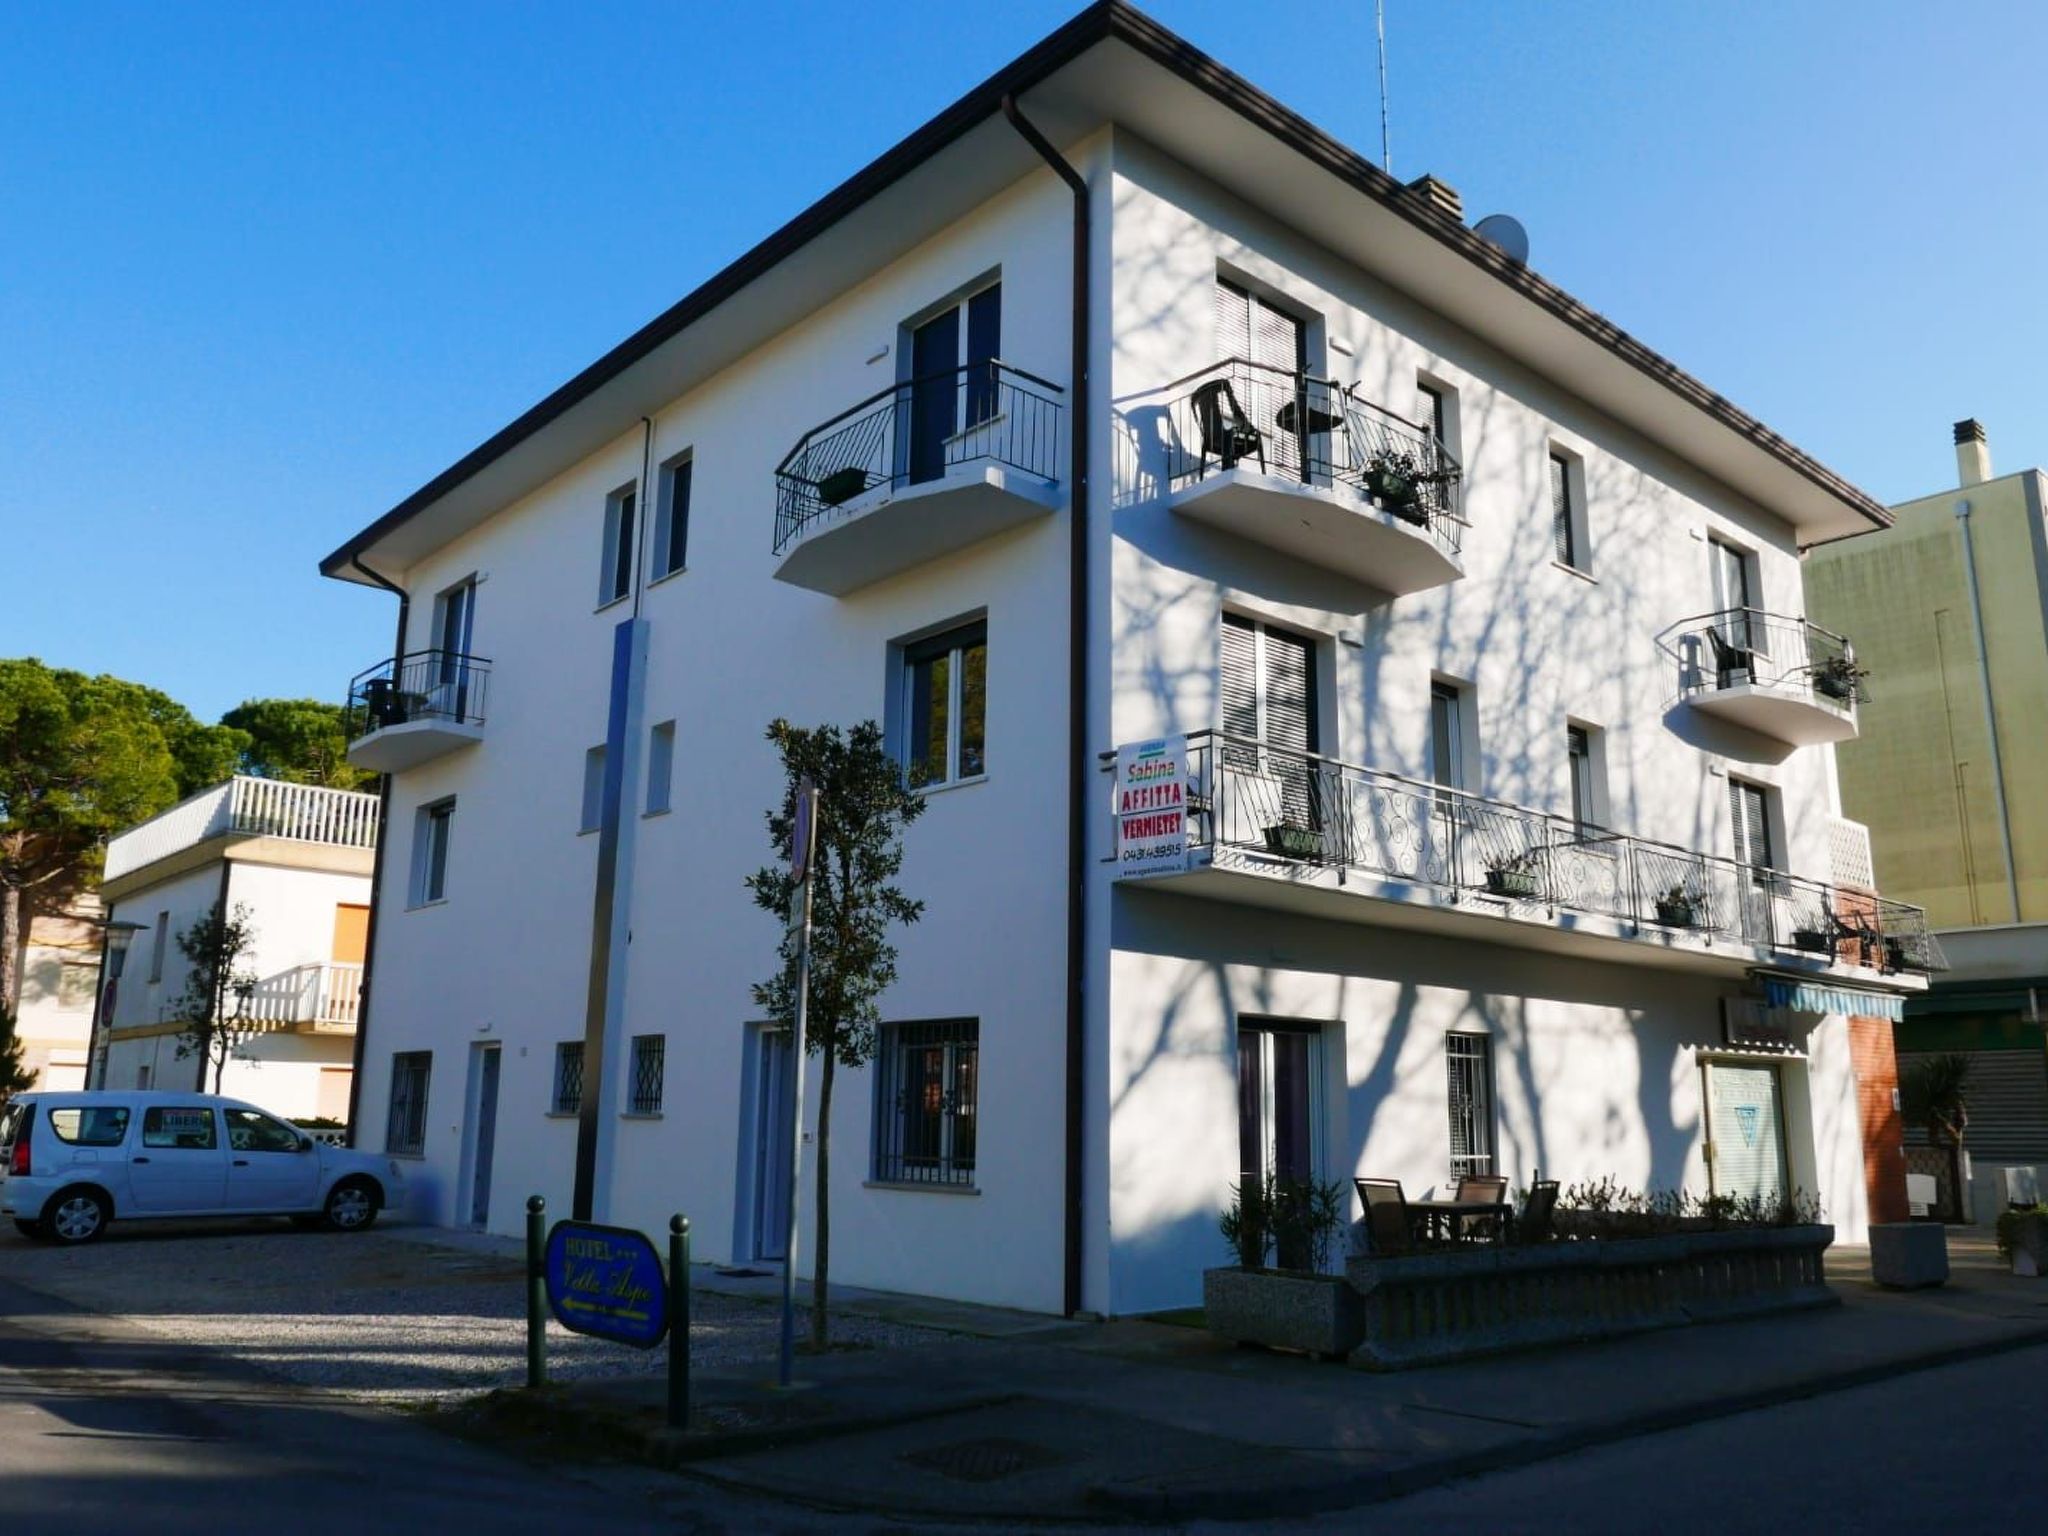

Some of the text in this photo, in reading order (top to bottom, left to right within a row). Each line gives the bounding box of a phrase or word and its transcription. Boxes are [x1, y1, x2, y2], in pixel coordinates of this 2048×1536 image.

[1127, 760, 1175, 782] Sabina
[1122, 783, 1182, 812] AFFITTA
[1122, 813, 1181, 840] VERMIETET
[566, 1239, 613, 1260] HOTEL
